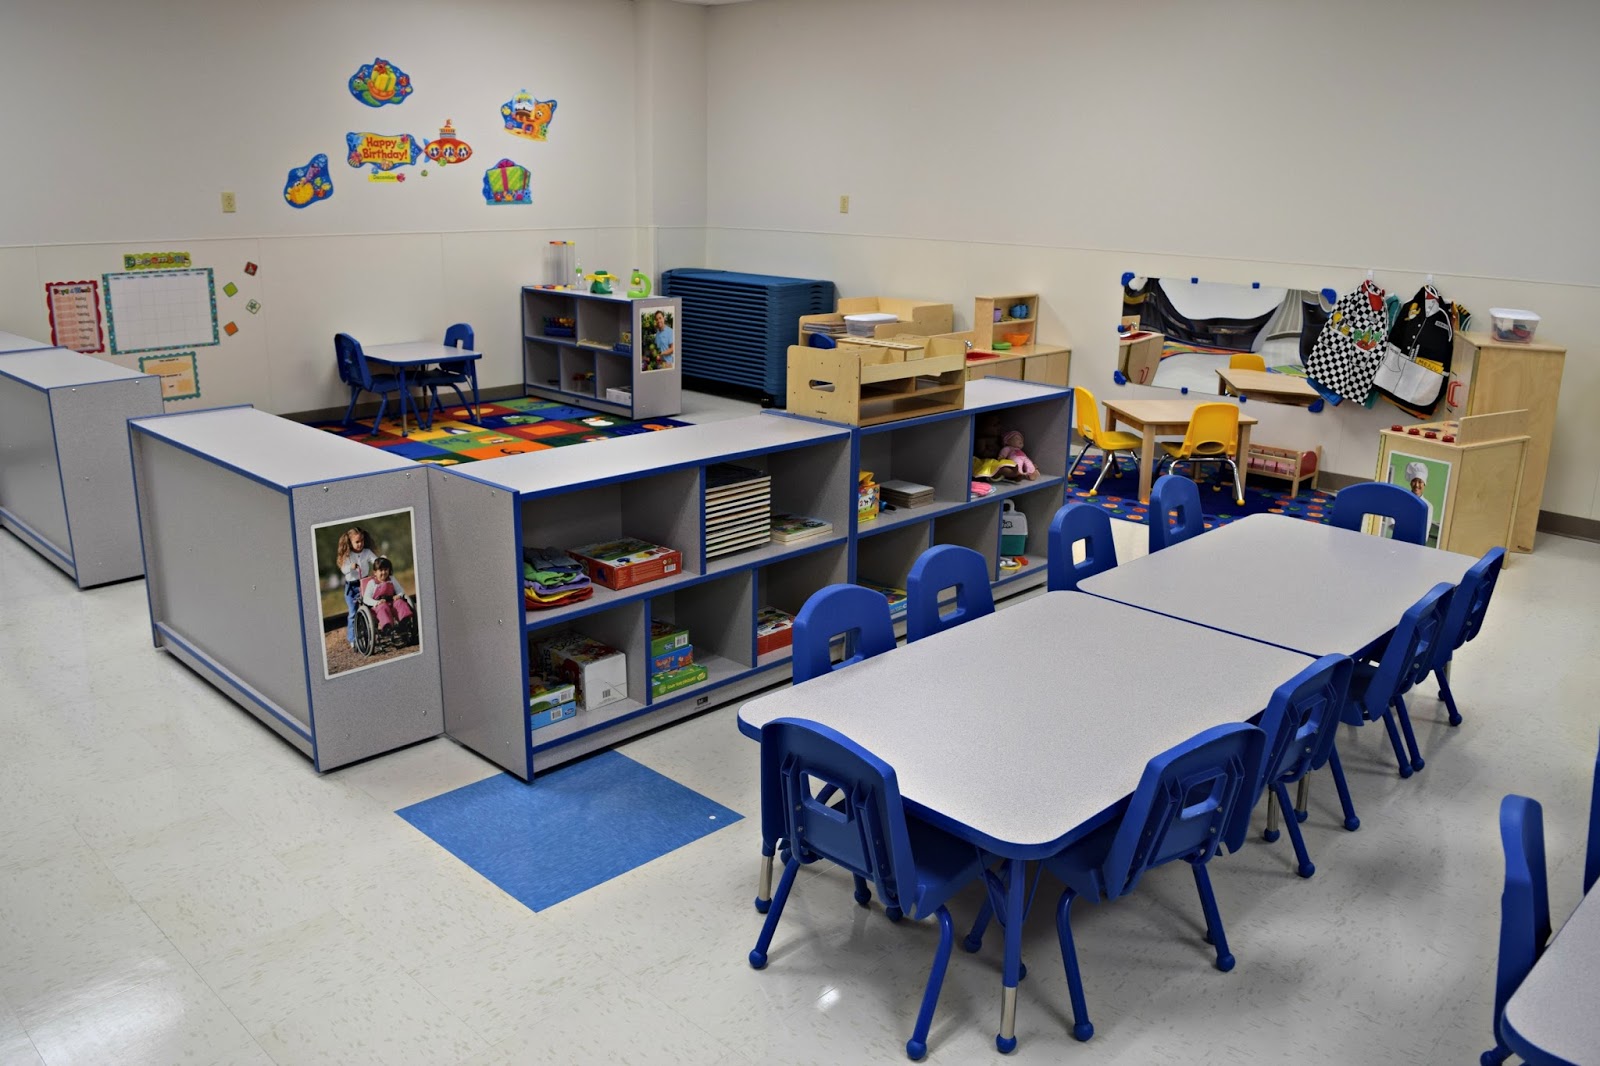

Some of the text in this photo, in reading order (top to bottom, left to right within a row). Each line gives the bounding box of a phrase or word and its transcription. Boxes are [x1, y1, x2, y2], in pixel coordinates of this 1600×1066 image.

[366, 138, 397, 149] Happy
[362, 149, 407, 159] Birthday!
[125, 255, 187, 268] December
[1418, 359, 1440, 372] MENU
